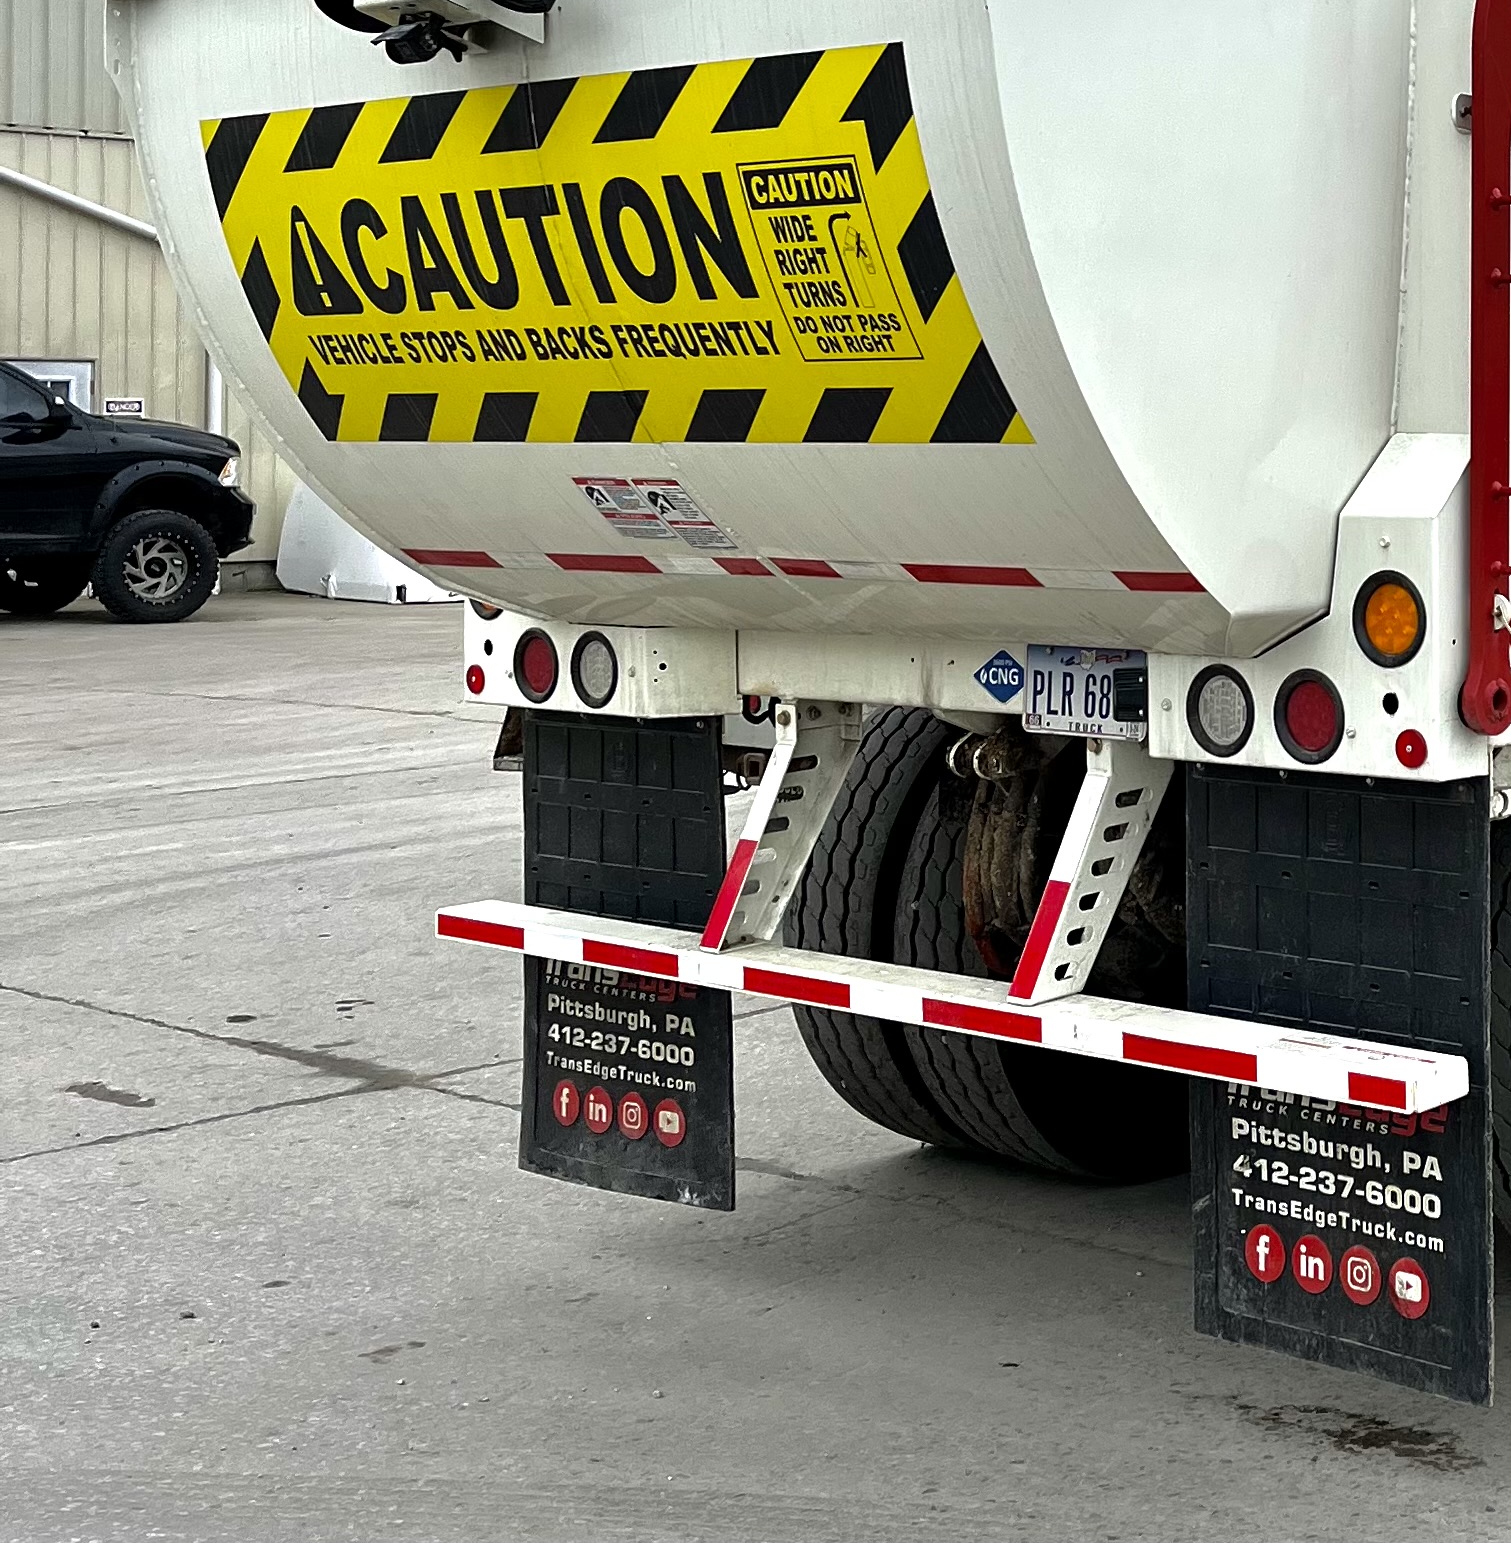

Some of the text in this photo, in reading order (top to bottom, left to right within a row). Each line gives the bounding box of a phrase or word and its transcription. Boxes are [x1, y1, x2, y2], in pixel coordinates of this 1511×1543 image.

[750, 169, 855, 204] CAUTION
[340, 171, 760, 315] CAUTION
[768, 214, 818, 244] WIDE
[773, 246, 831, 277] RIGHT
[782, 279, 848, 309] TURNS
[307, 319, 781, 366] VEHICLE STOPS AND BACKS FREQUENTLY
[793, 312, 902, 334] DO NOT PASS
[816, 333, 896, 354] ON RIGHT
[988, 667, 1020, 686] CNG
[1031, 669, 1112, 720] PLR 68
[1068, 720, 1104, 734] TRUCK
[545, 975, 657, 1003] TRUCK CENTERS
[547, 993, 696, 1037] Pittsburgh, PA
[547, 1023, 696, 1067] 412-237-6000
[546, 1051, 697, 1093] TransEdgeTruck.com
[1227, 1095, 1289, 1116] TRUCK
[1300, 1109, 1389, 1136] CENTERS
[1231, 1116, 1444, 1182] Pittsburgh, PA
[1232, 1153, 1442, 1220] 412-237-6000
[1231, 1188, 1445, 1253] TransEdgeTruck.com
